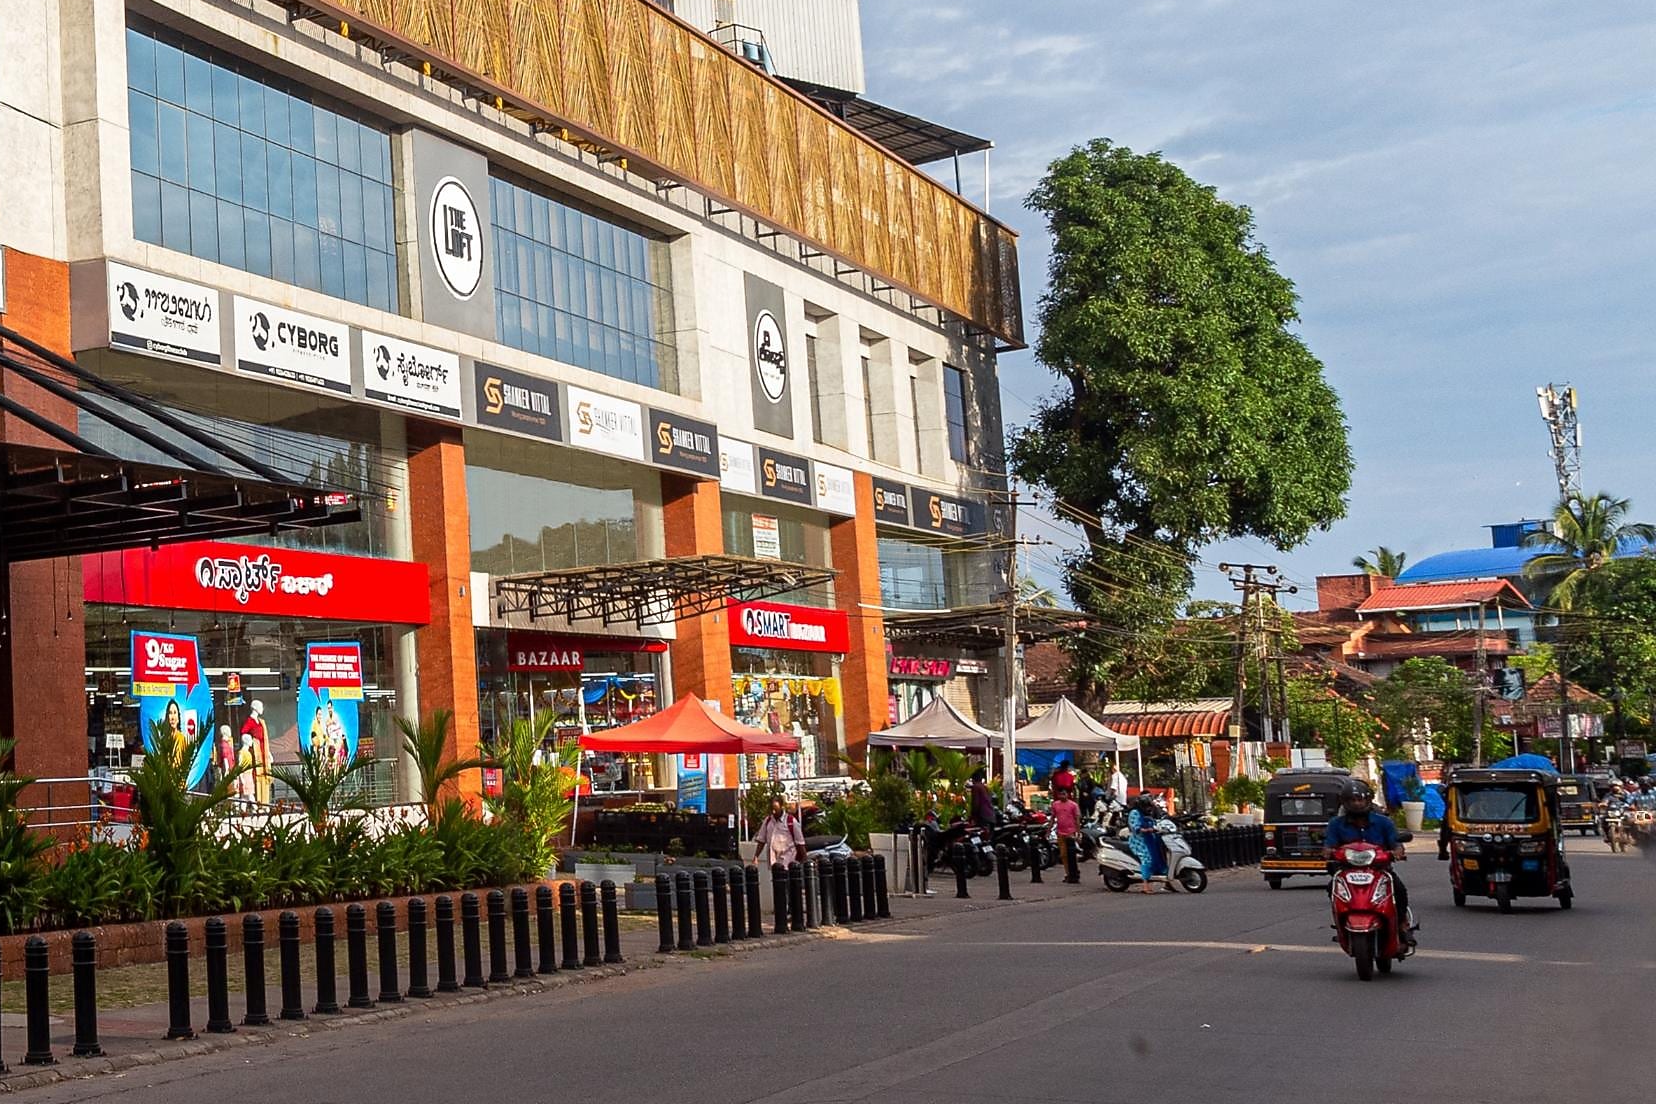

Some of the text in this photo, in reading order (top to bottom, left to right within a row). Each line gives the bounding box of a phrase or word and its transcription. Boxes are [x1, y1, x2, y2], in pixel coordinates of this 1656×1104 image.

[448, 206, 467, 231] THE
[278, 322, 339, 357] CYBORG
[755, 608, 791, 639] SMART
[145, 638, 160, 668] 9
[159, 653, 187, 671] Sugar
[517, 650, 581, 666] BAZAAR
